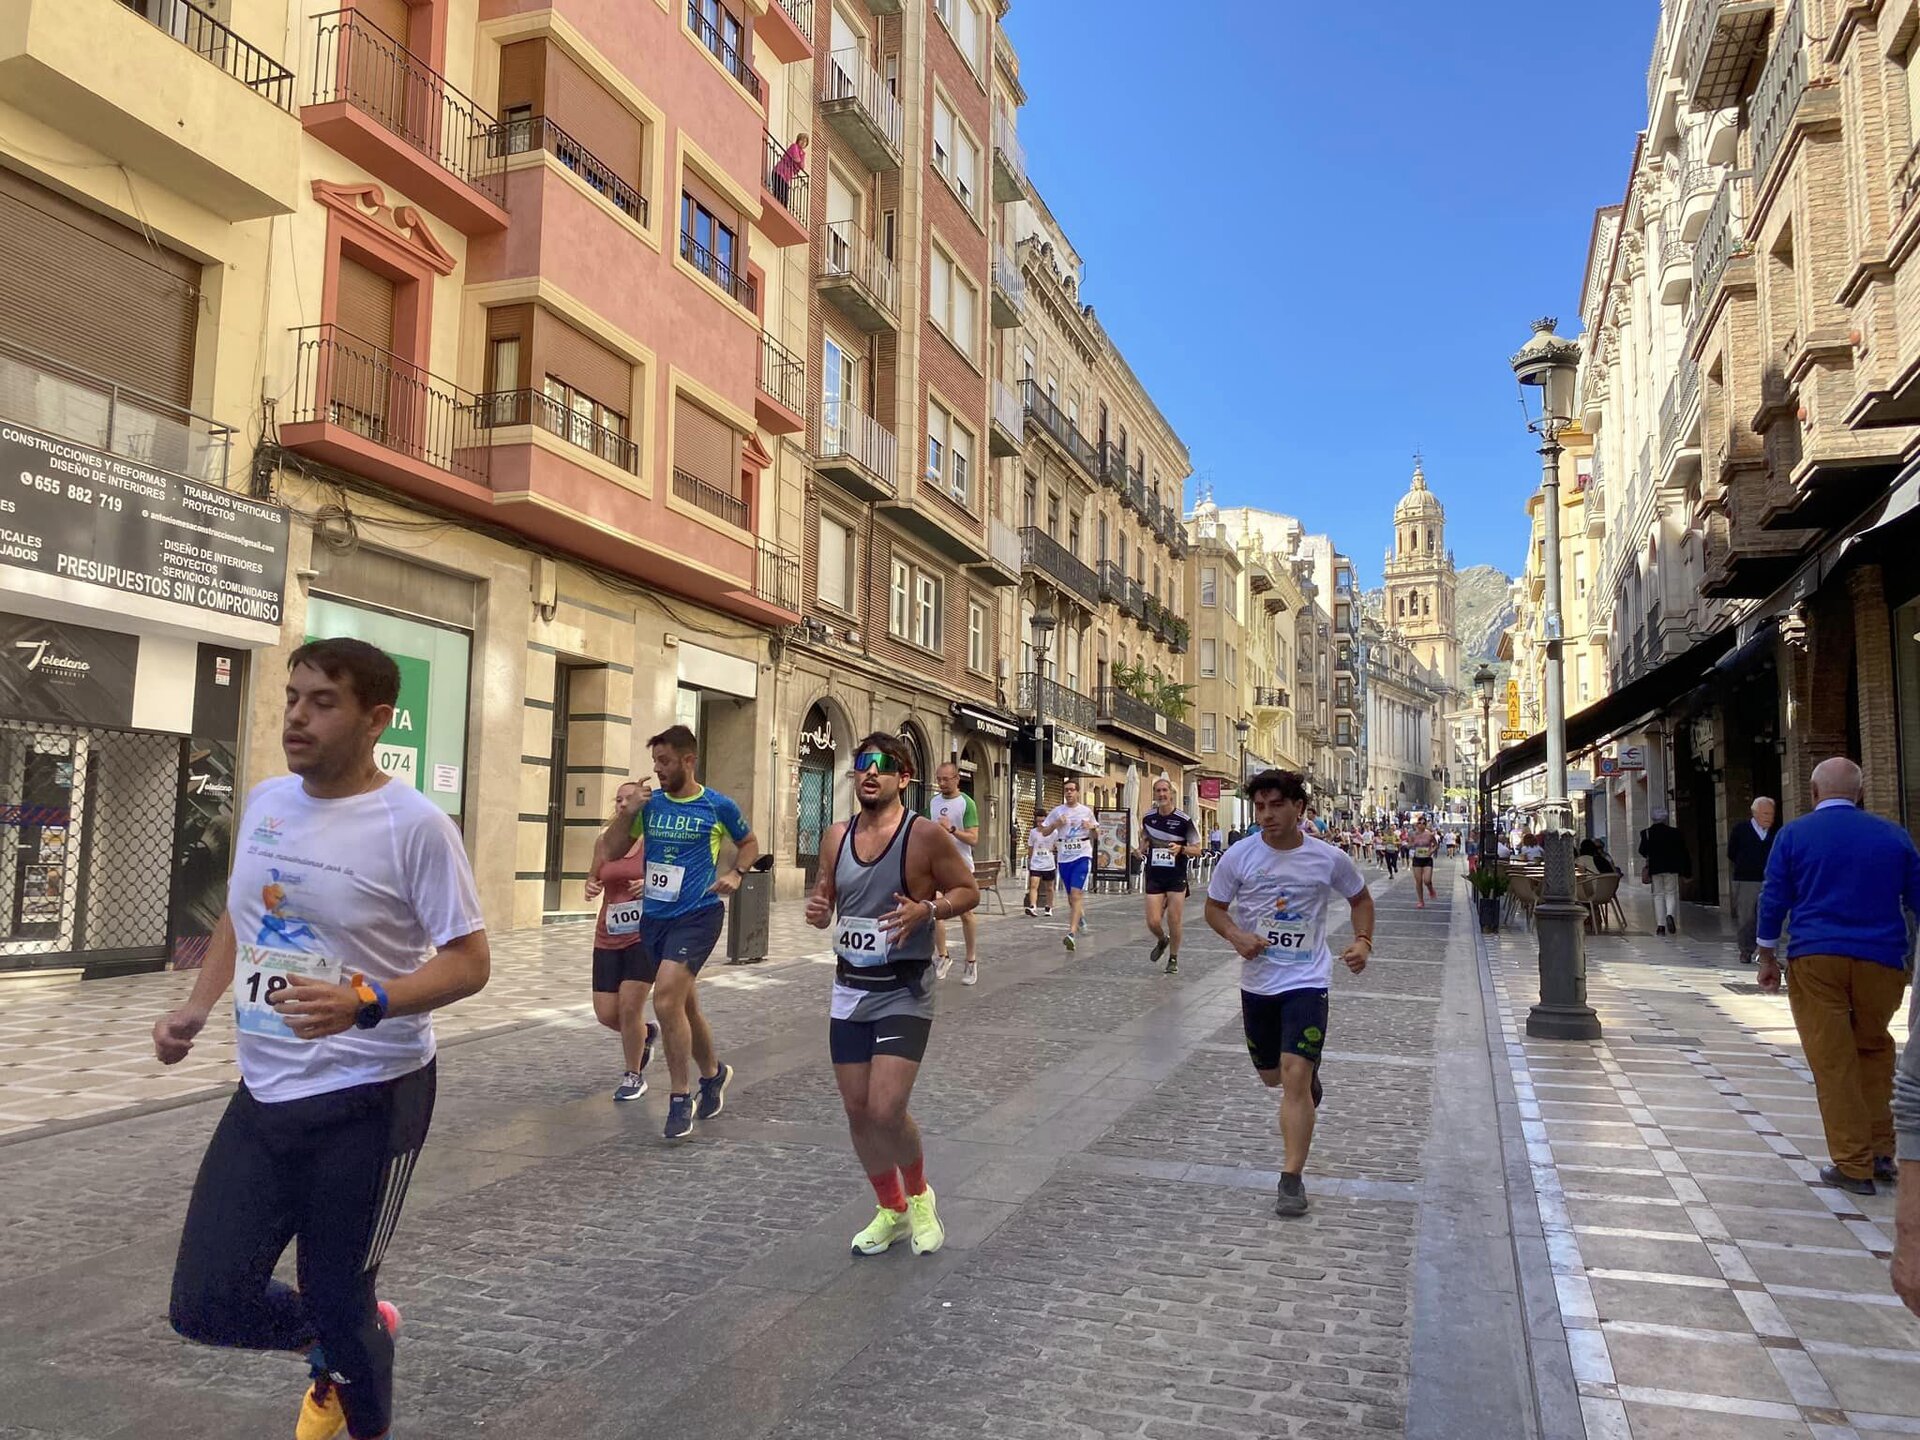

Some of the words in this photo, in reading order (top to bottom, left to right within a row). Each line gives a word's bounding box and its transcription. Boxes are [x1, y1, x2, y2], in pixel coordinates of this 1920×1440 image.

[2, 428, 102, 467] CONSTRUCCIONES
[104, 460, 112, 470] Y
[113, 463, 167, 488] REFORMAS
[184, 484, 231, 508] TRABAJOS
[232, 501, 281, 523] VERTICALES
[50, 457, 90, 478] DISEÑO
[92, 471, 106, 483] DE
[108, 474, 166, 501] INTERIORES
[182, 497, 236, 521] PROYECTOS
[34, 475, 61, 495] 655
[67, 484, 93, 504] 882
[99, 493, 122, 512] 719
[163, 553, 218, 575] PROYECTOS
[164, 540, 199, 556] DISEÑO
[200, 549, 213, 560] DE
[214, 552, 263, 574] INTERIORES
[56, 553, 171, 597] PRESUPUESTOS
[173, 581, 195, 602] SIN
[198, 588, 279, 621] COMPROMISO
[162, 565, 210, 586] SERVICIOS
[211, 578, 219, 588] A
[219, 580, 279, 602] COMUNIDADES
[15, 640, 91, 671] Toledano
[1509, 681, 1518, 728] AMATE
[381, 751, 411, 772] 074
[648, 812, 705, 832] LLLBLT
[652, 873, 668, 888] 99
[611, 909, 640, 925] 100
[840, 931, 876, 951] 402
[1267, 931, 1306, 948] 567
